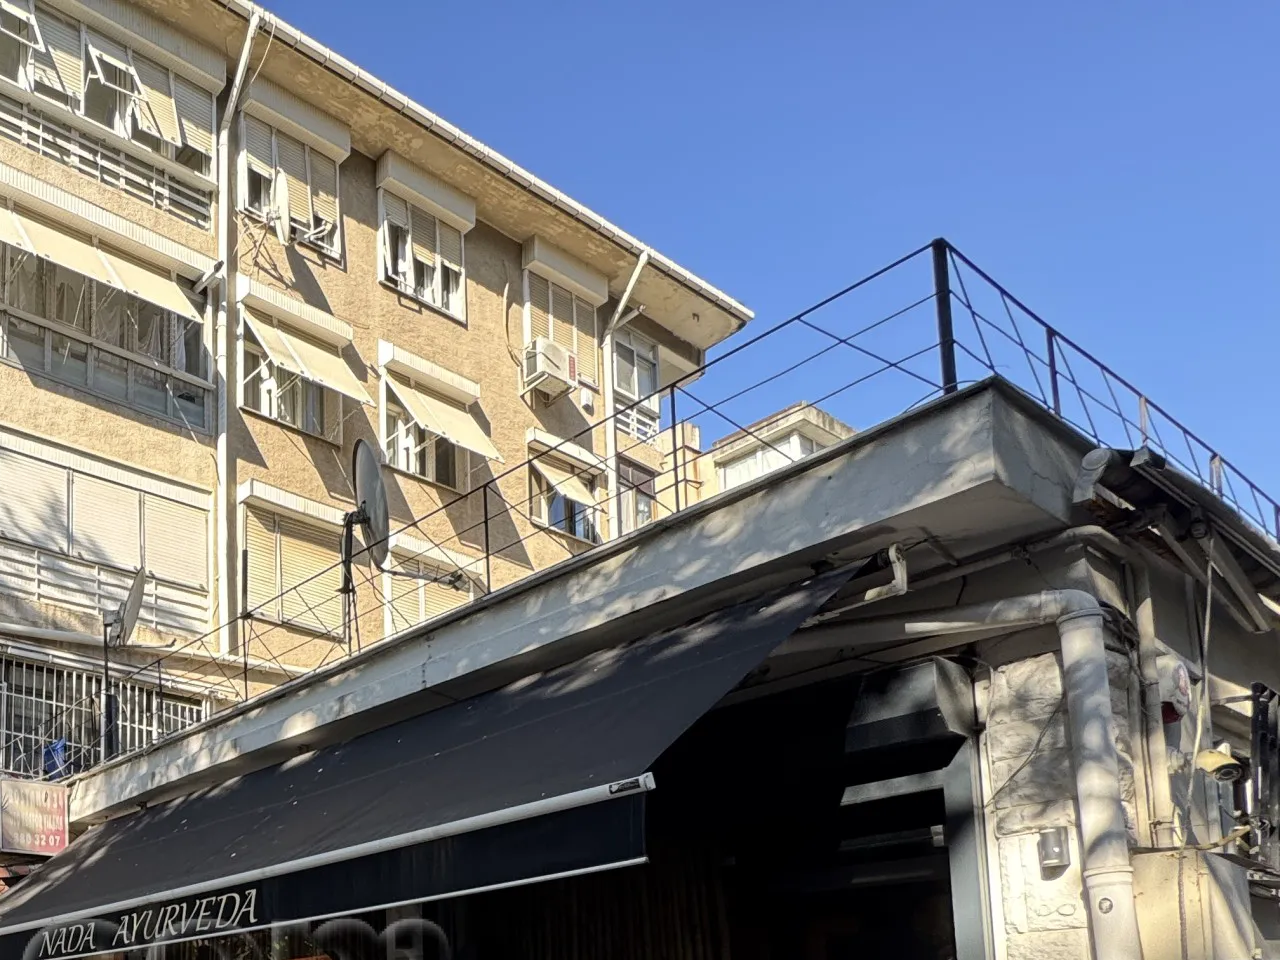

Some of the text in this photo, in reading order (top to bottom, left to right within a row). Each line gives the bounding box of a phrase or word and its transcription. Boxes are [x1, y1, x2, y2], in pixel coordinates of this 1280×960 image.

[34, 834, 47, 845] 32
[48, 835, 61, 846] 07
[37, 888, 260, 957] NADA AYURVEDA
